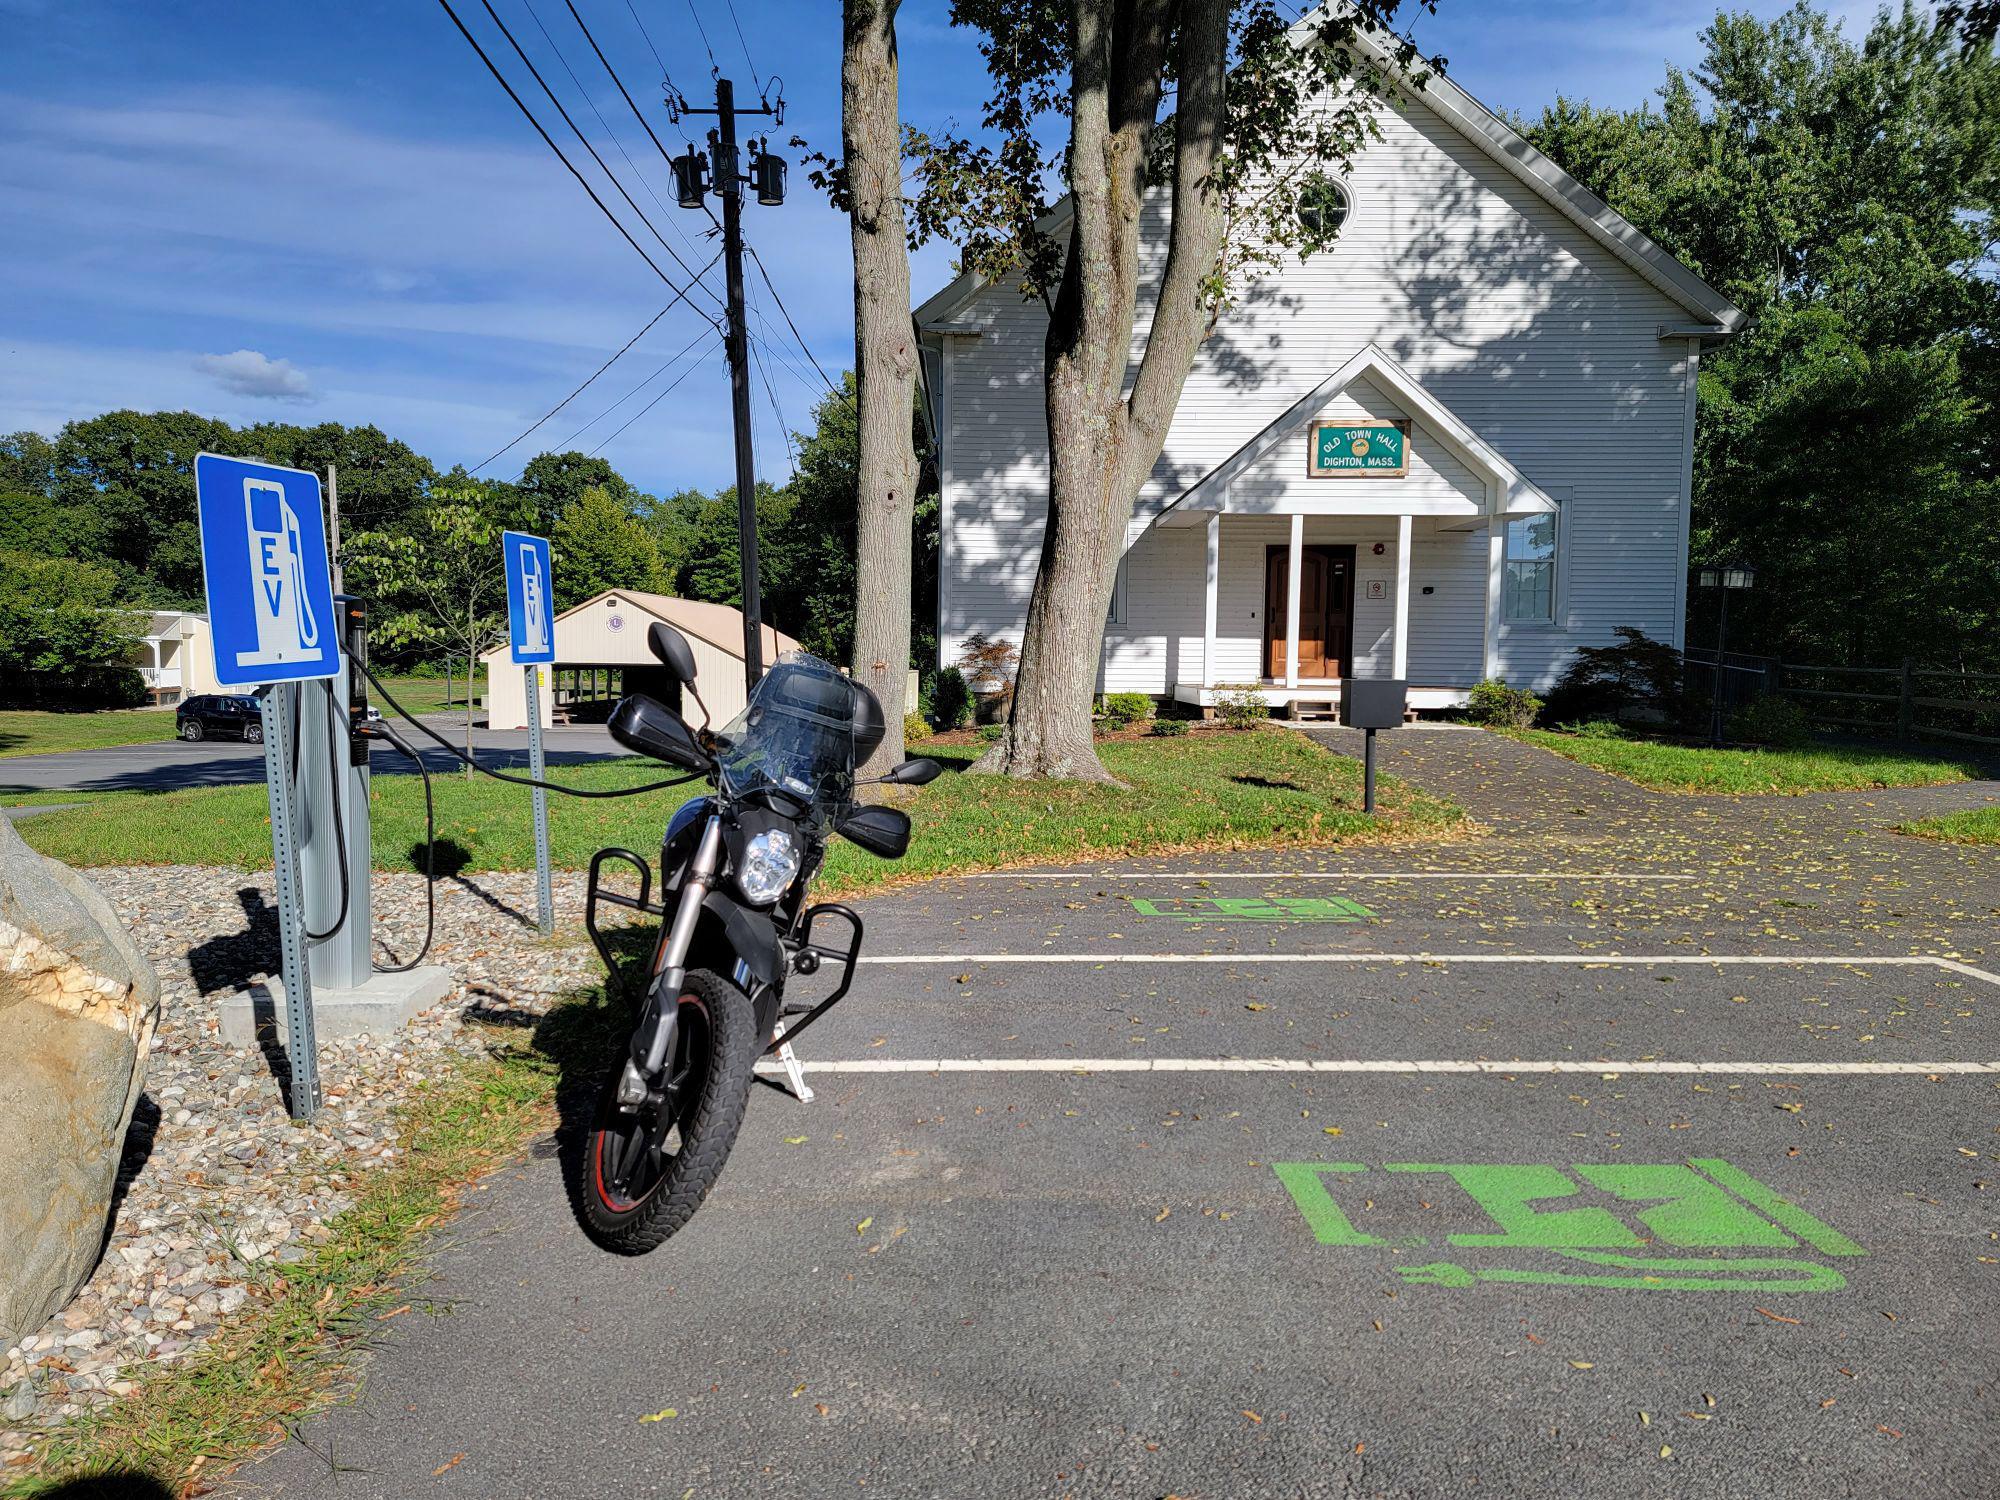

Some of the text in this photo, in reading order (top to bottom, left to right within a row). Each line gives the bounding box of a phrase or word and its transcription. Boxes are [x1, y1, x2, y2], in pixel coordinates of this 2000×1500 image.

[1323, 429, 1398, 453] OLD TOWN HALL
[1367, 457, 1396, 467] MASS.
[260, 536, 283, 618] EV
[527, 578, 536, 625] EV
